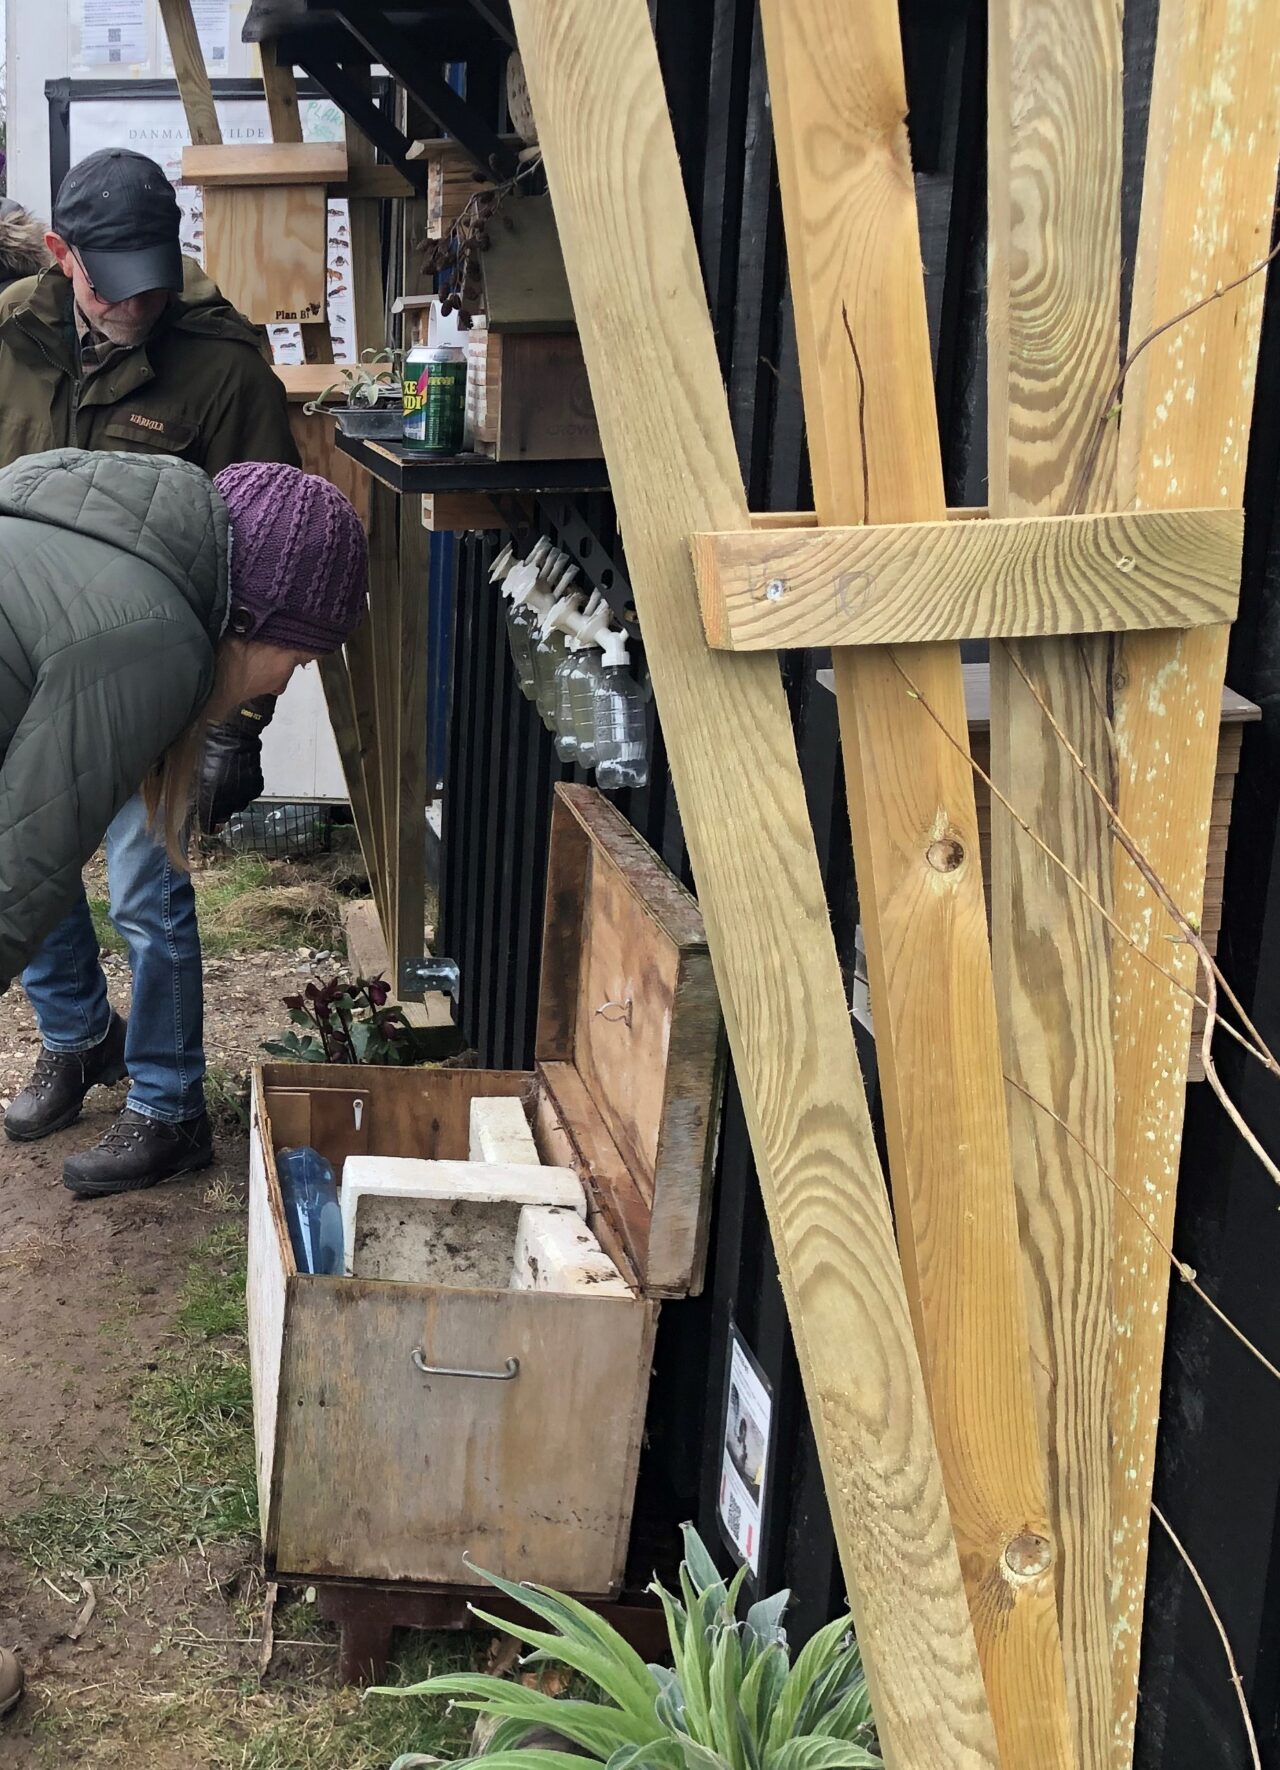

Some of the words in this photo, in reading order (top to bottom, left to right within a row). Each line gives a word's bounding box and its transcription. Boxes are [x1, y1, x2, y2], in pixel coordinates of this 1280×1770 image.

[129, 129, 190, 140] DANMA
[222, 127, 265, 139] ILDE
[275, 310, 297, 320] Plan
[403, 381, 418, 395] XE
